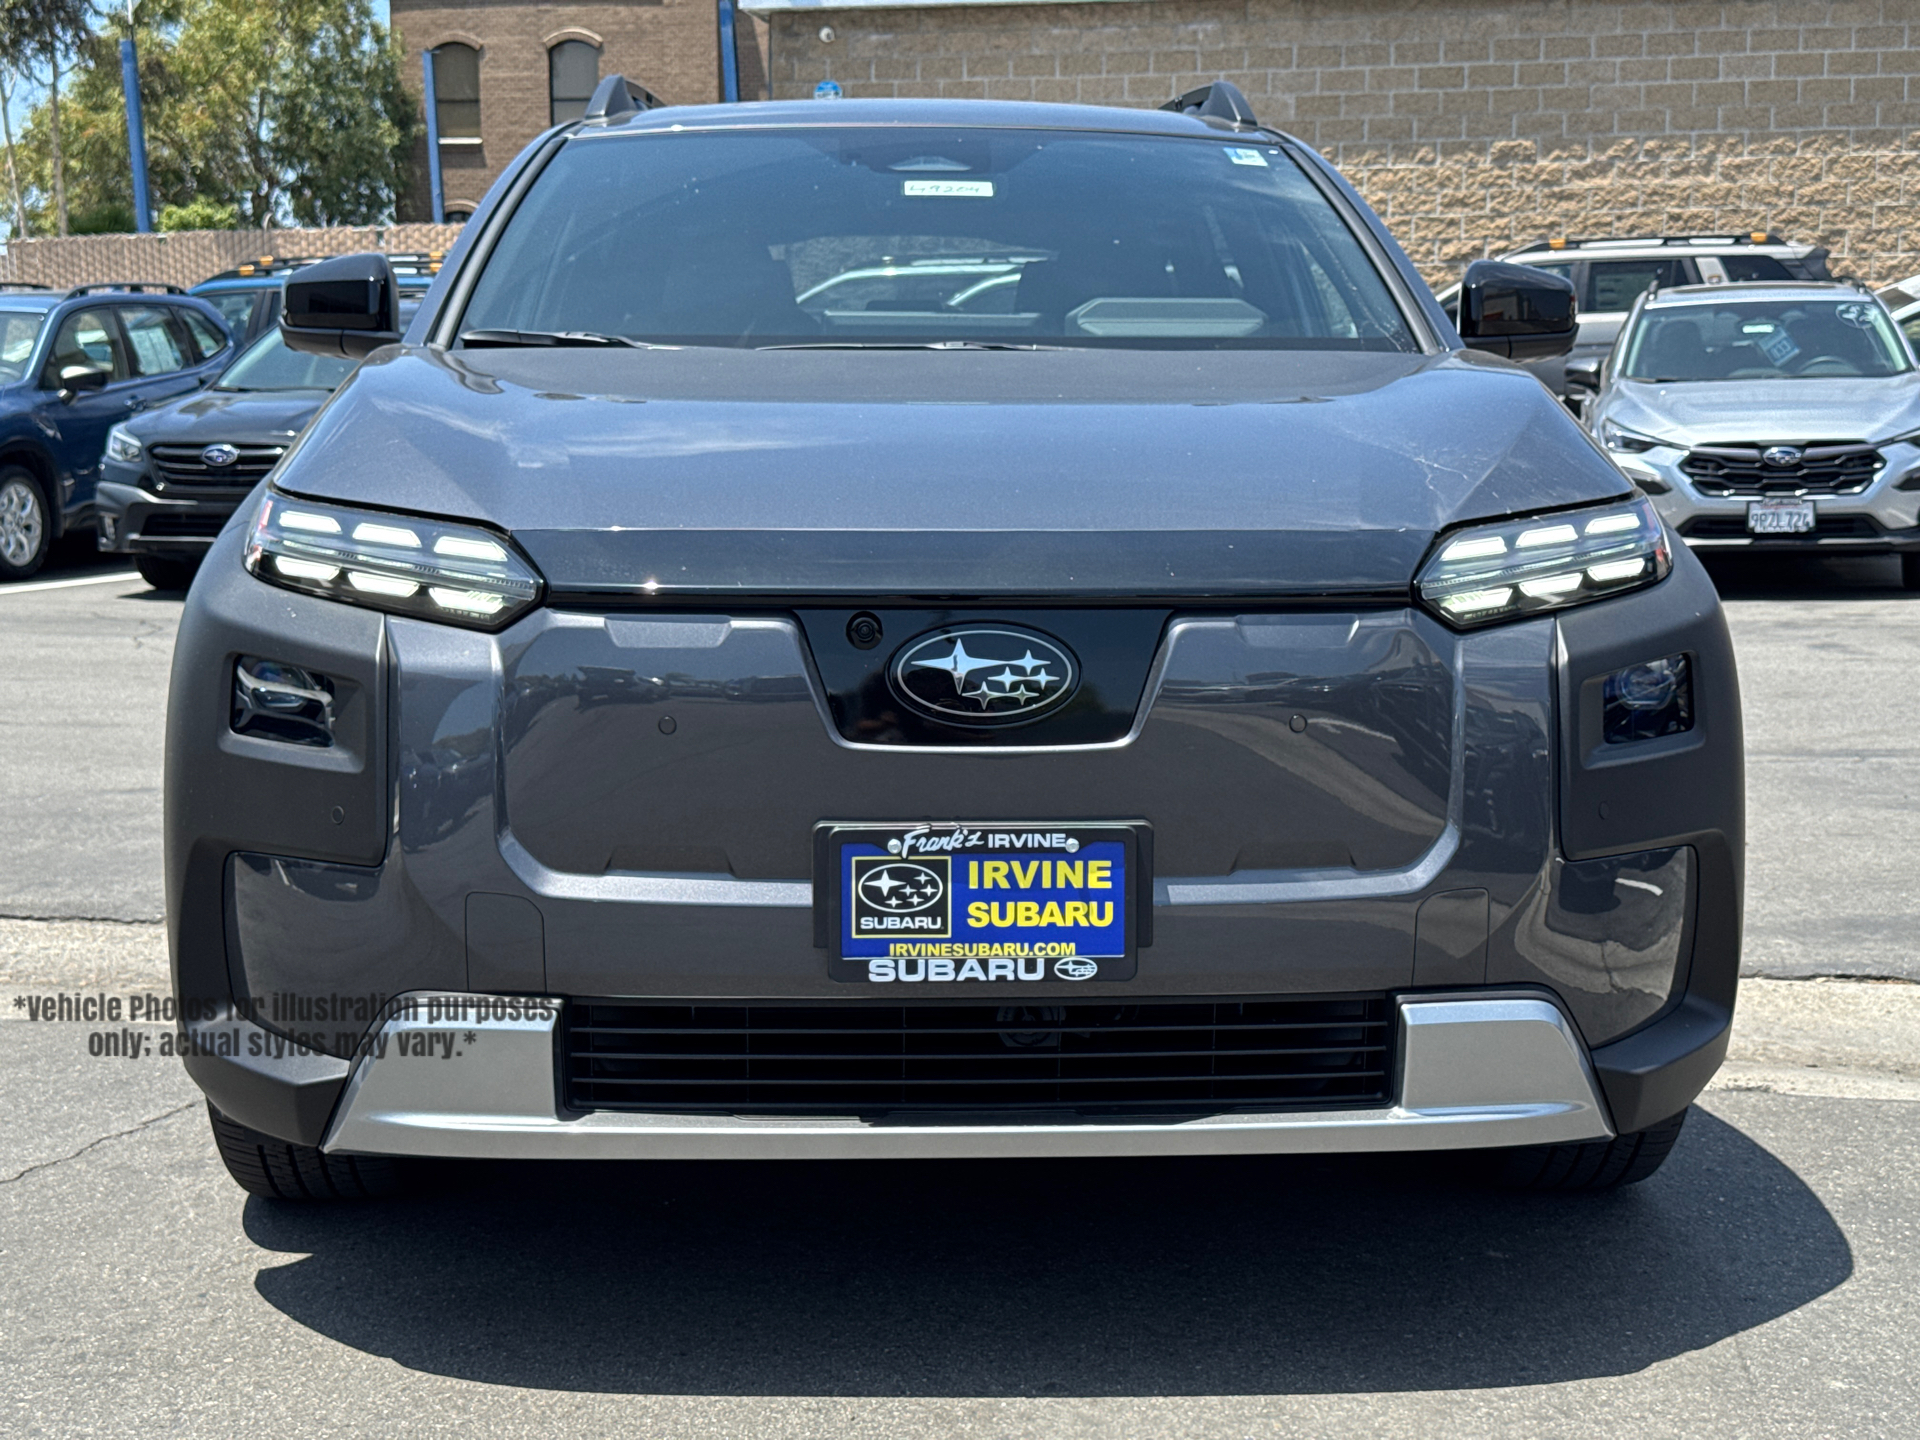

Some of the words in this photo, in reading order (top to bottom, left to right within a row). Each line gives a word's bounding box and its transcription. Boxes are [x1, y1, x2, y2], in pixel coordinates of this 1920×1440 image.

[902, 822, 985, 859] Frank's
[987, 833, 1067, 848] IRVINE
[968, 860, 1112, 889] IRVINE
[860, 916, 942, 930] SUBARU
[967, 901, 1114, 928] SUBARU
[889, 942, 1077, 957] IRVINESUBARU.COM
[868, 957, 1046, 983] SUBARU
